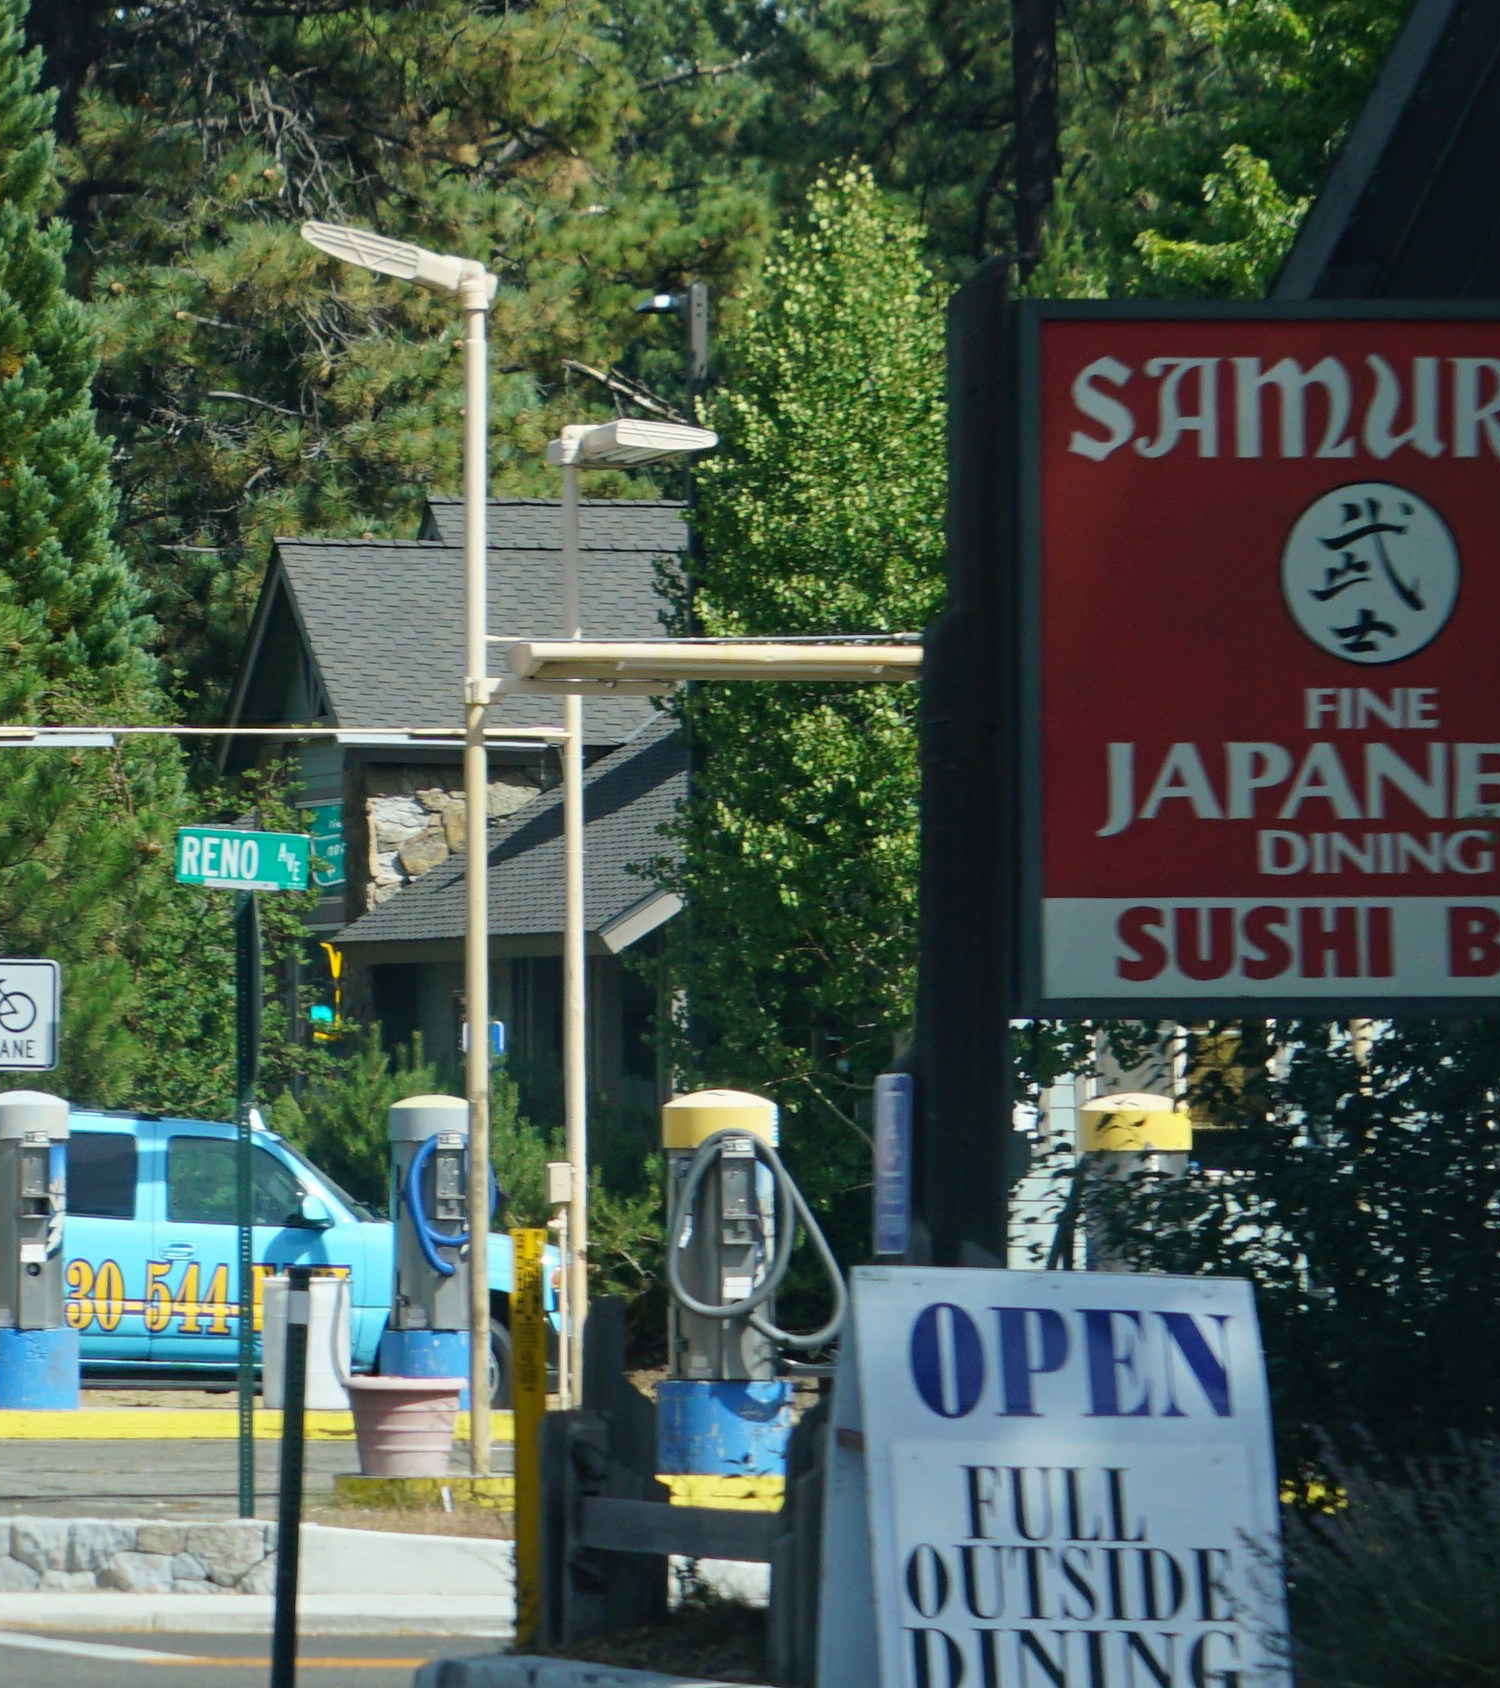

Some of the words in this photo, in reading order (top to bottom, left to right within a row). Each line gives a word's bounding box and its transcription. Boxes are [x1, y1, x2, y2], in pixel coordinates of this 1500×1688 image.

[1309, 496, 1427, 652] 武士
[1304, 687, 1441, 729] FINE
[181, 836, 259, 880] RENO
[277, 842, 301, 881] AVE
[1258, 829, 1496, 876] DINING
[1116, 906, 1396, 981] SUSHI
[911, 1302, 1237, 1419] OPEN
[960, 1464, 1148, 1542] FULL
[906, 1542, 1238, 1622] OUTSIDE
[903, 1626, 1241, 1688] DINING
